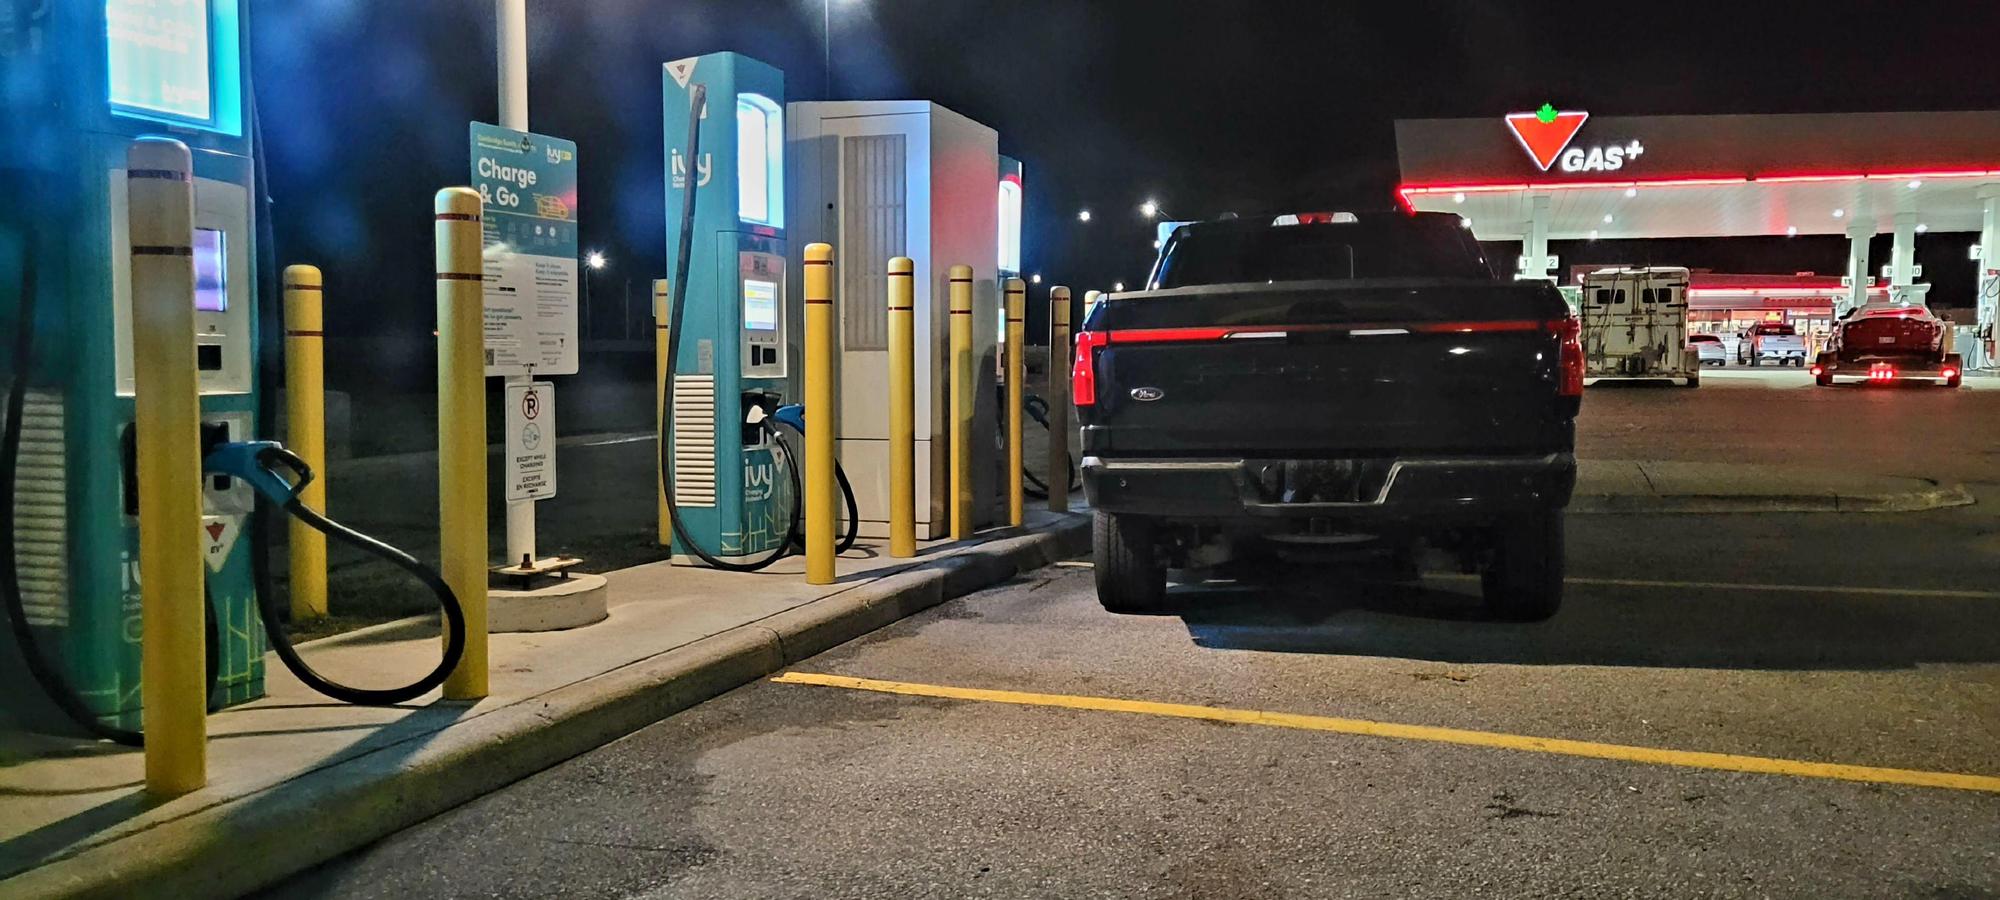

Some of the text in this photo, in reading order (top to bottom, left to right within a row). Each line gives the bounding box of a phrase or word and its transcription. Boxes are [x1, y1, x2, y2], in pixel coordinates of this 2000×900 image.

[546, 144, 560, 164] ivy
[1561, 139, 1644, 172] GAS+
[478, 157, 537, 189] Charge
[480, 183, 519, 207] & Go
[744, 458, 773, 500] ivy
